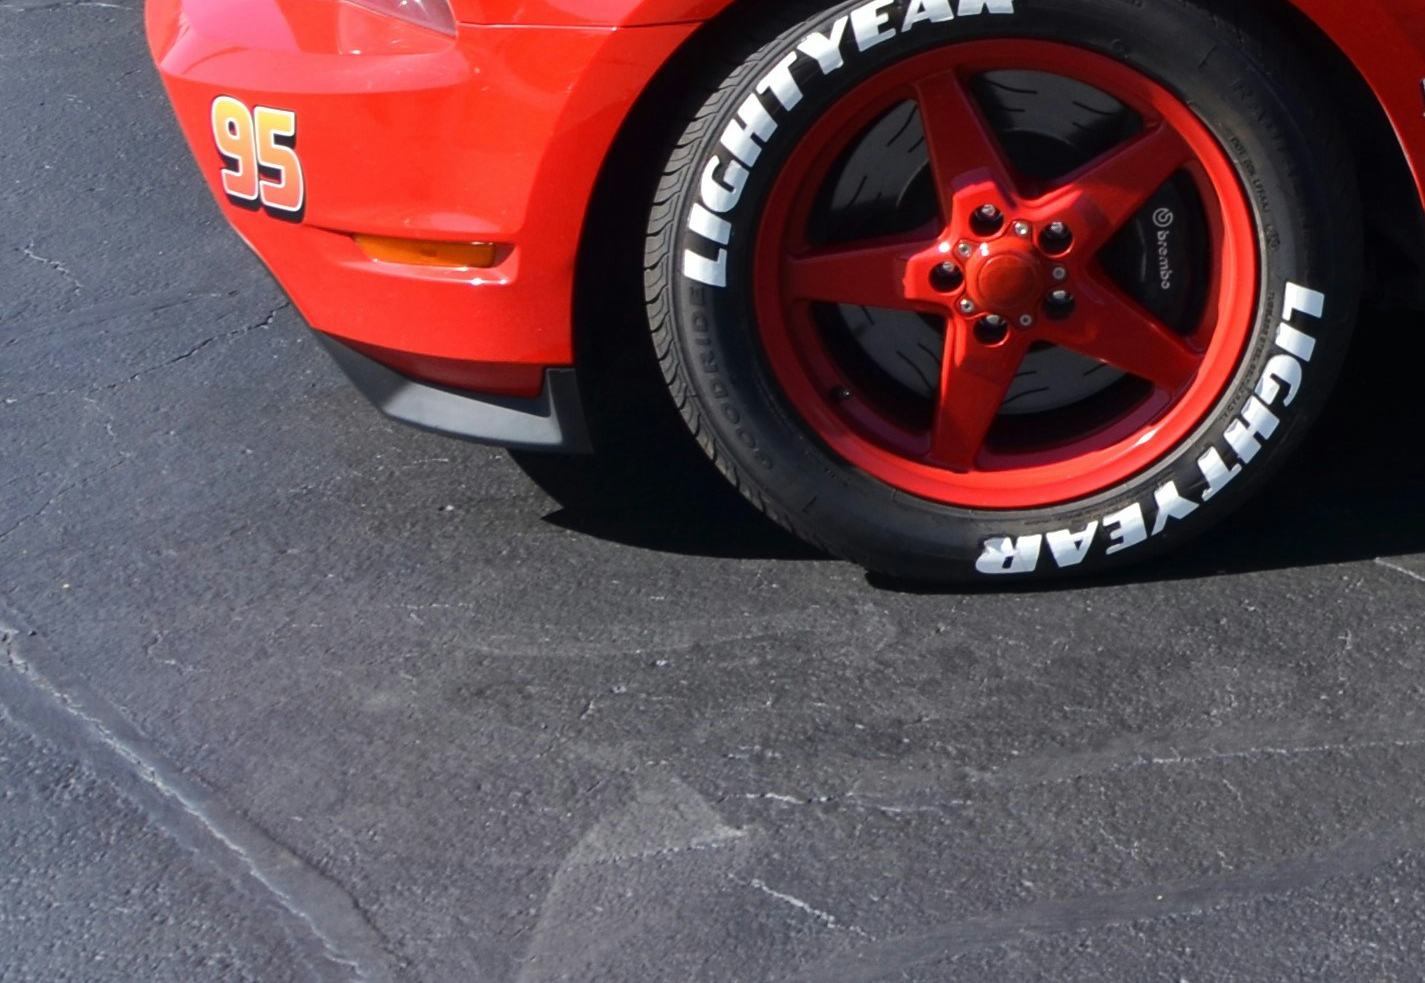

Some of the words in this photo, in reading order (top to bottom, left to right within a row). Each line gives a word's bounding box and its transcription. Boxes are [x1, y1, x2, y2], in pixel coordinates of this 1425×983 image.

[211, 95, 304, 213] 95
[1156, 229, 1173, 290] brembo
[975, 281, 1326, 574] LIGHTYEAR
